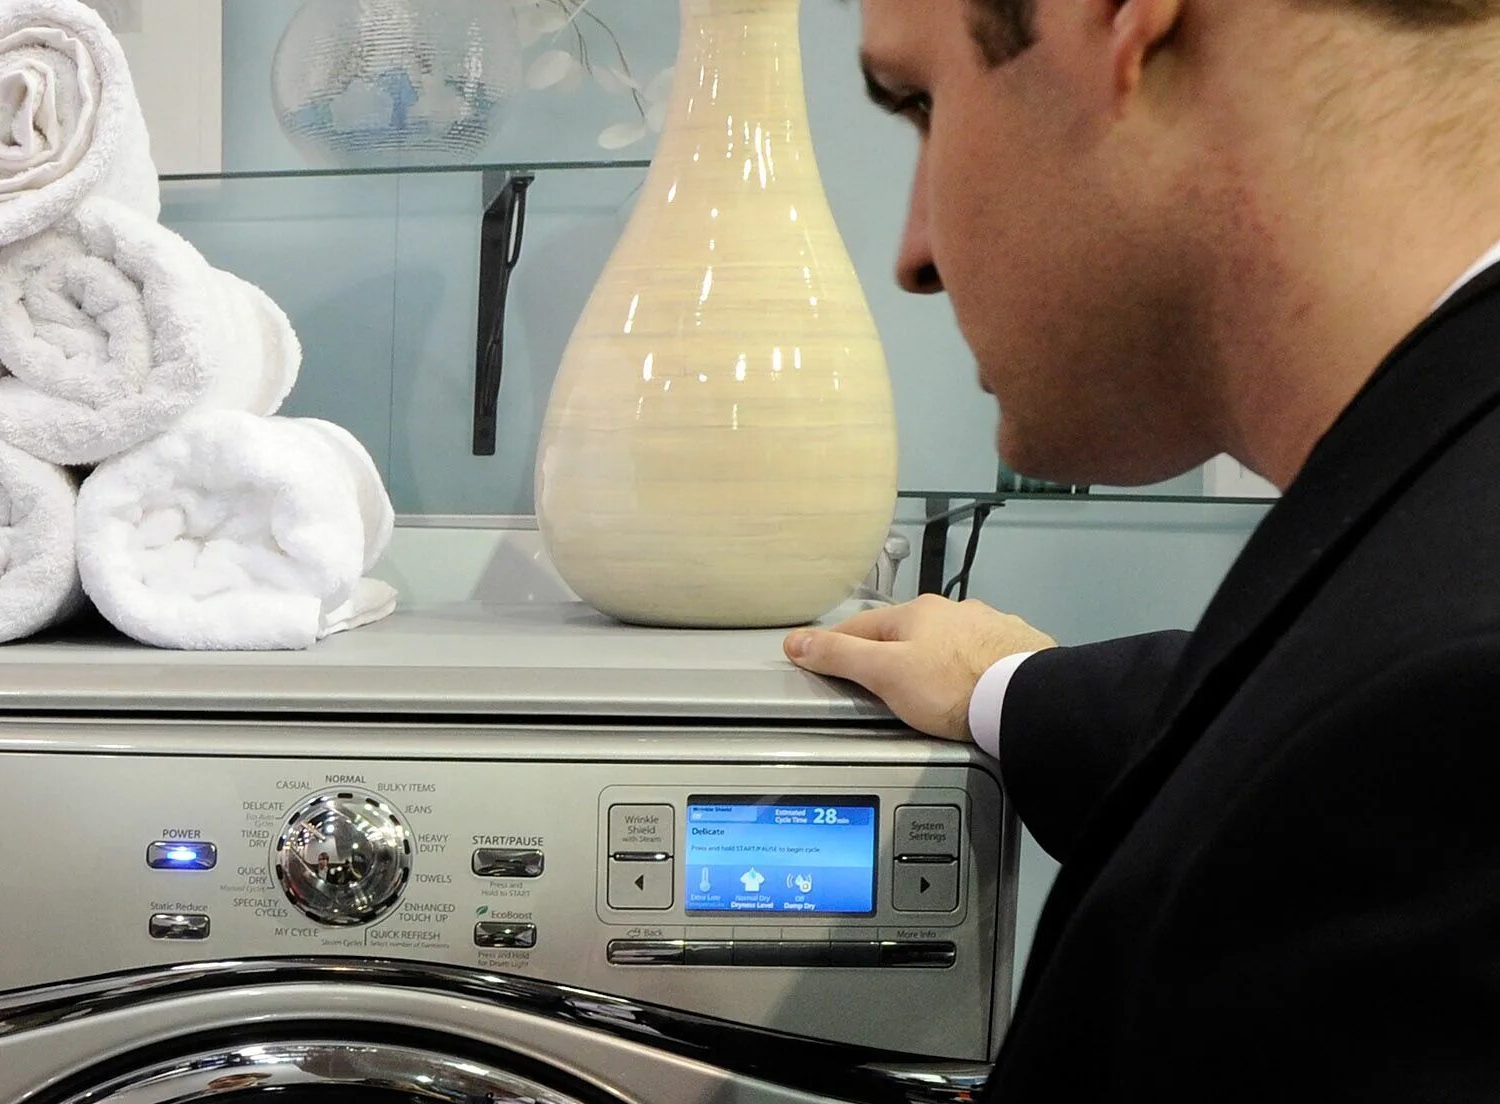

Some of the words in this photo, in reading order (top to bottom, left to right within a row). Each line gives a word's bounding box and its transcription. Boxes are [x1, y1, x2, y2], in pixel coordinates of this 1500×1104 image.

[325, 775, 366, 784] NORMAL
[276, 781, 312, 790] CASUAL
[378, 783, 408, 792] BULKY
[409, 784, 436, 793] ITEMS
[243, 802, 284, 811] DELICATE
[404, 805, 432, 814] JEANS
[625, 815, 659, 824] Wrinkle
[813, 808, 837, 824] 28
[628, 825, 656, 835] Shield
[911, 821, 945, 831] System
[163, 829, 201, 838] POWER
[241, 830, 270, 838] TIMED
[692, 828, 725, 836] Delicate
[909, 831, 947, 842] Settings
[418, 834, 449, 842] HEAVY
[472, 835, 544, 846] START/PAUSE
[250, 840, 268, 848] DRY
[420, 844, 446, 853] DUTY
[237, 867, 266, 876] QUICK
[248, 876, 267, 885] DRY
[415, 874, 452, 884] TOWELS
[150, 902, 175, 911] Static
[176, 903, 208, 912] Reduce
[232, 899, 278, 908] SPECIALTY
[404, 904, 456, 912] ENHANCED
[730, 902, 755, 910] Dryness
[784, 902, 801, 910] Damp
[803, 902, 816, 910] Dry
[255, 908, 288, 918] CYCLES
[400, 913, 431, 922] TOUCH
[435, 914, 449, 922] UP
[491, 911, 532, 920] EcoBoost
[274, 928, 288, 936] MY
[290, 928, 319, 937] CYCLE
[370, 930, 401, 939] QUICK
[401, 931, 440, 940] REFRESH
[644, 929, 662, 937] Back
[897, 930, 918, 938] More
[920, 930, 937, 938] Info
